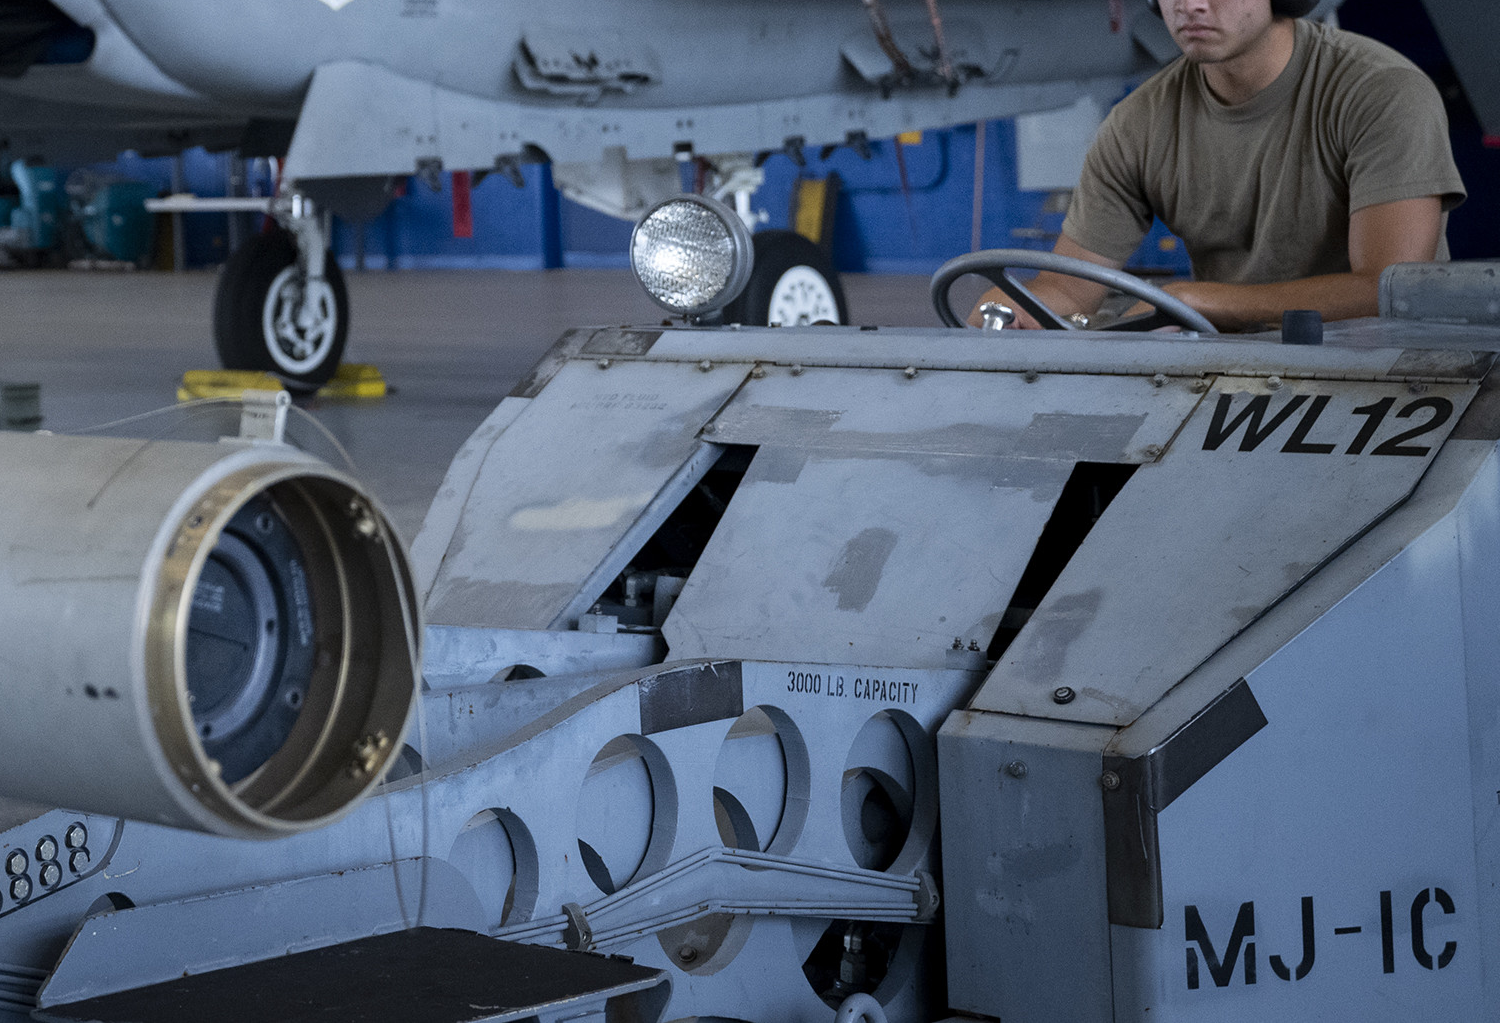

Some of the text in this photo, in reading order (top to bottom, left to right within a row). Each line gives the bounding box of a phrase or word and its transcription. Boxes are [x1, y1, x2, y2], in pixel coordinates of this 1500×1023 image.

[1202, 393, 1454, 457] WL12
[787, 671, 918, 704] 3000 LB. CAPACITY
